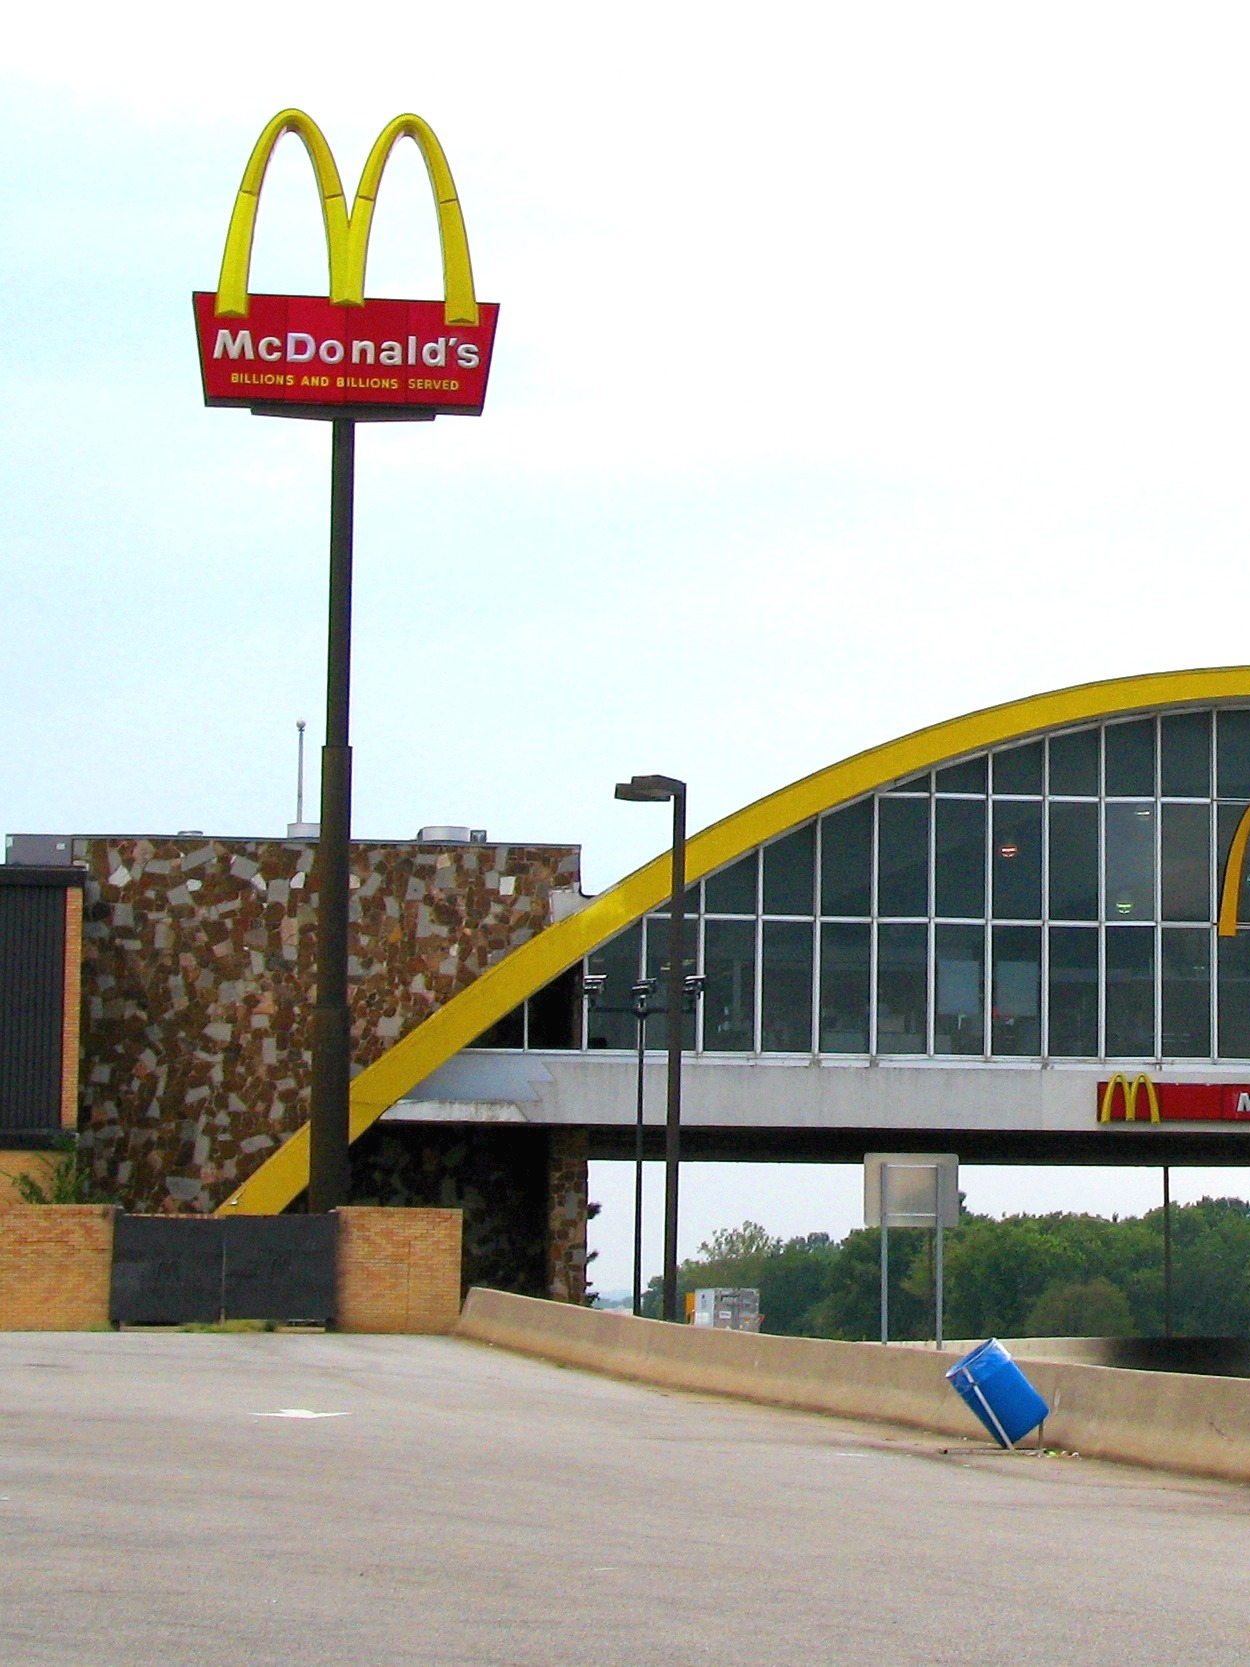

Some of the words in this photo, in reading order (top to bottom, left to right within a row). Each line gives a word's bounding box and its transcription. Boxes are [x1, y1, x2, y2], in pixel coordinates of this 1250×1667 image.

[212, 328, 480, 369] McDonald's
[230, 372, 295, 386] BILLIONS
[300, 375, 330, 387] AND
[336, 376, 399, 389] BILLIONS
[408, 378, 460, 391] SERVED
